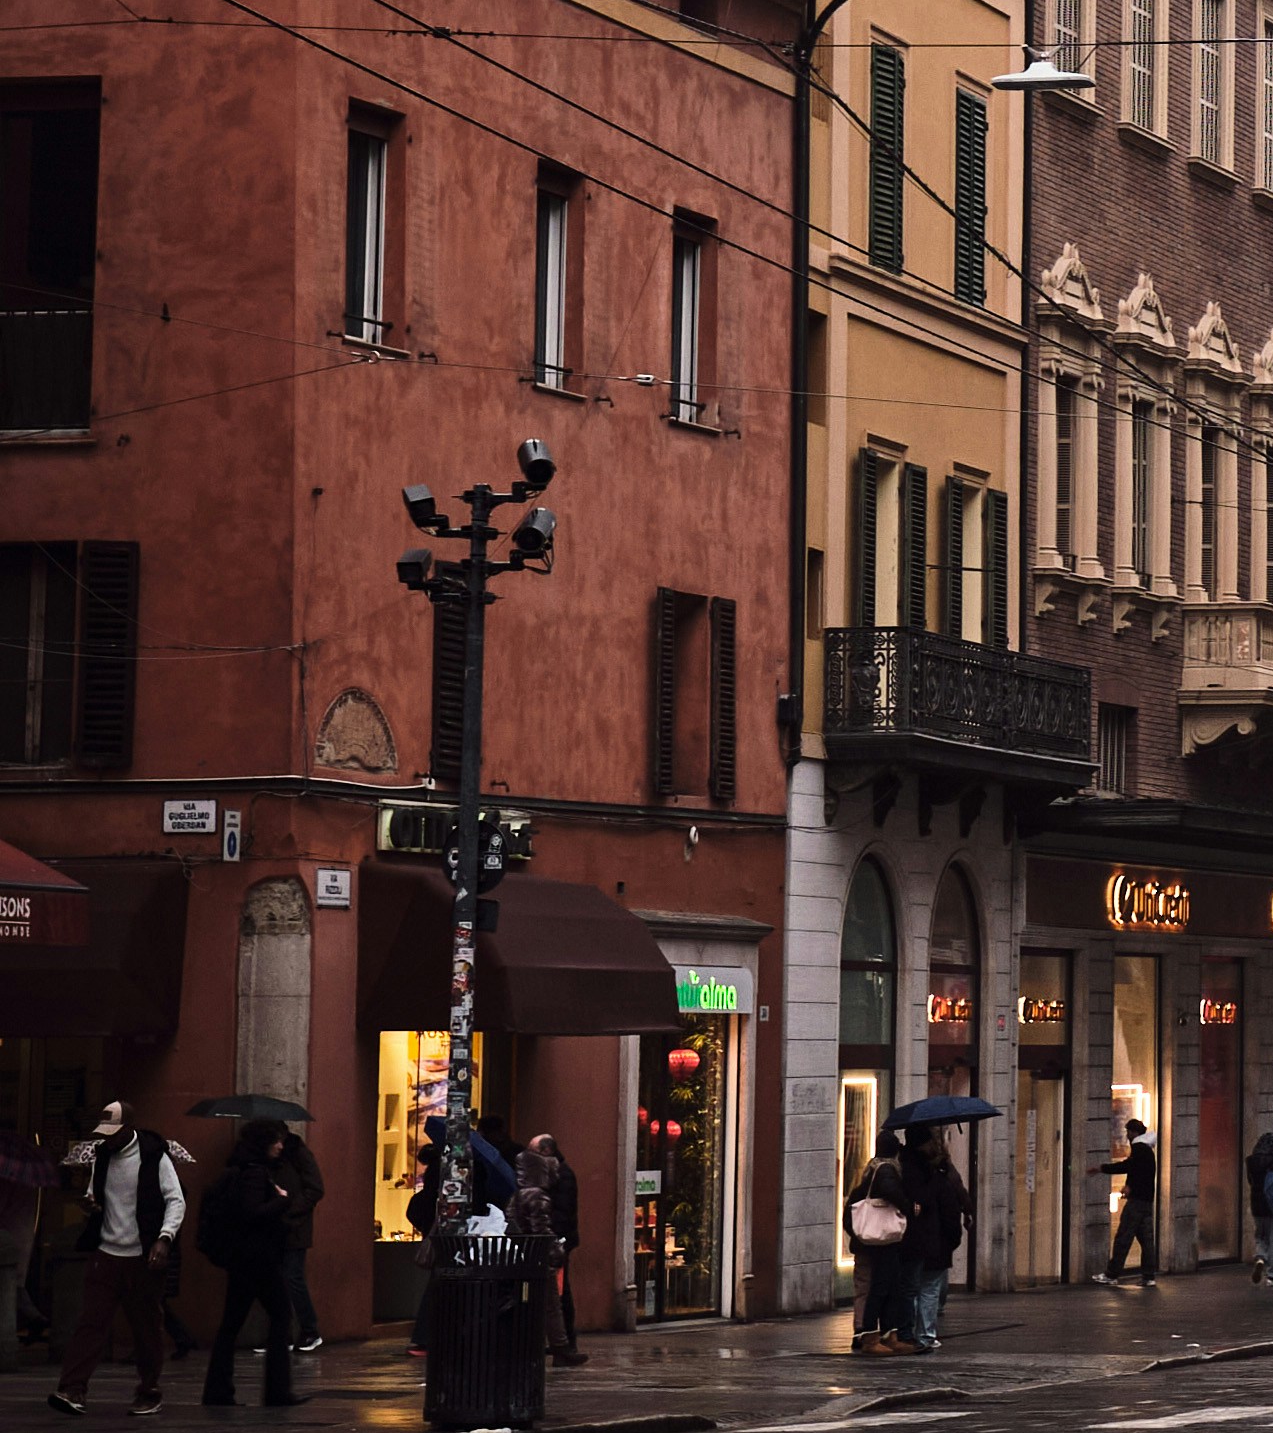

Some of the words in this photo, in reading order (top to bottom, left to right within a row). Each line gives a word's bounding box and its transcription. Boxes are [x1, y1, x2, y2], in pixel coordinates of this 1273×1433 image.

[183, 803, 196, 811] VIA
[168, 811, 210, 820] GUGLIELMO
[171, 821, 207, 830] OBERDAN
